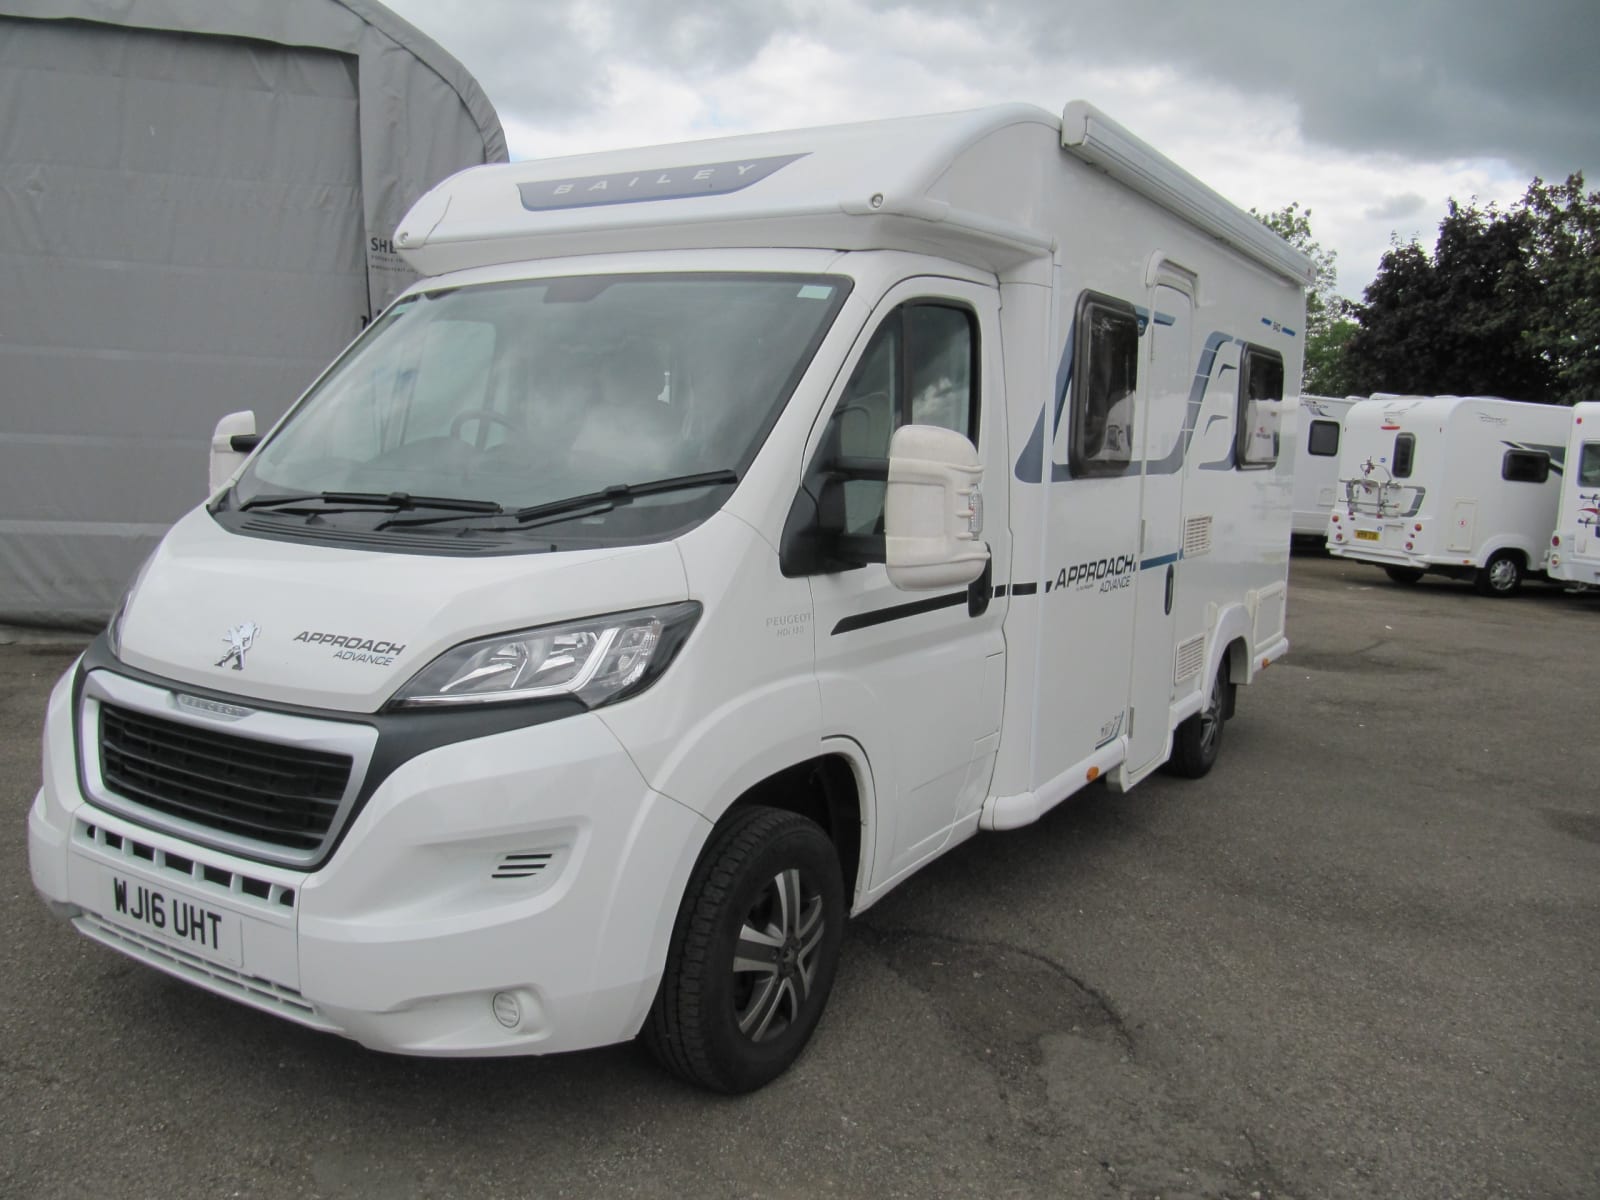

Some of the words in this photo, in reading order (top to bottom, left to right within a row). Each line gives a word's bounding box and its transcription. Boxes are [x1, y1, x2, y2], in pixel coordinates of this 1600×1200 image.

[553, 164, 756, 195] BAILEY
[1055, 553, 1133, 590] APPROACH
[1100, 575, 1131, 593] ADVANCE
[765, 612, 812, 627] PEUGEOT
[293, 630, 407, 657] APPROACH
[333, 650, 395, 667] ADVANCE
[113, 876, 166, 929] WJ16
[173, 899, 222, 950] UHT
